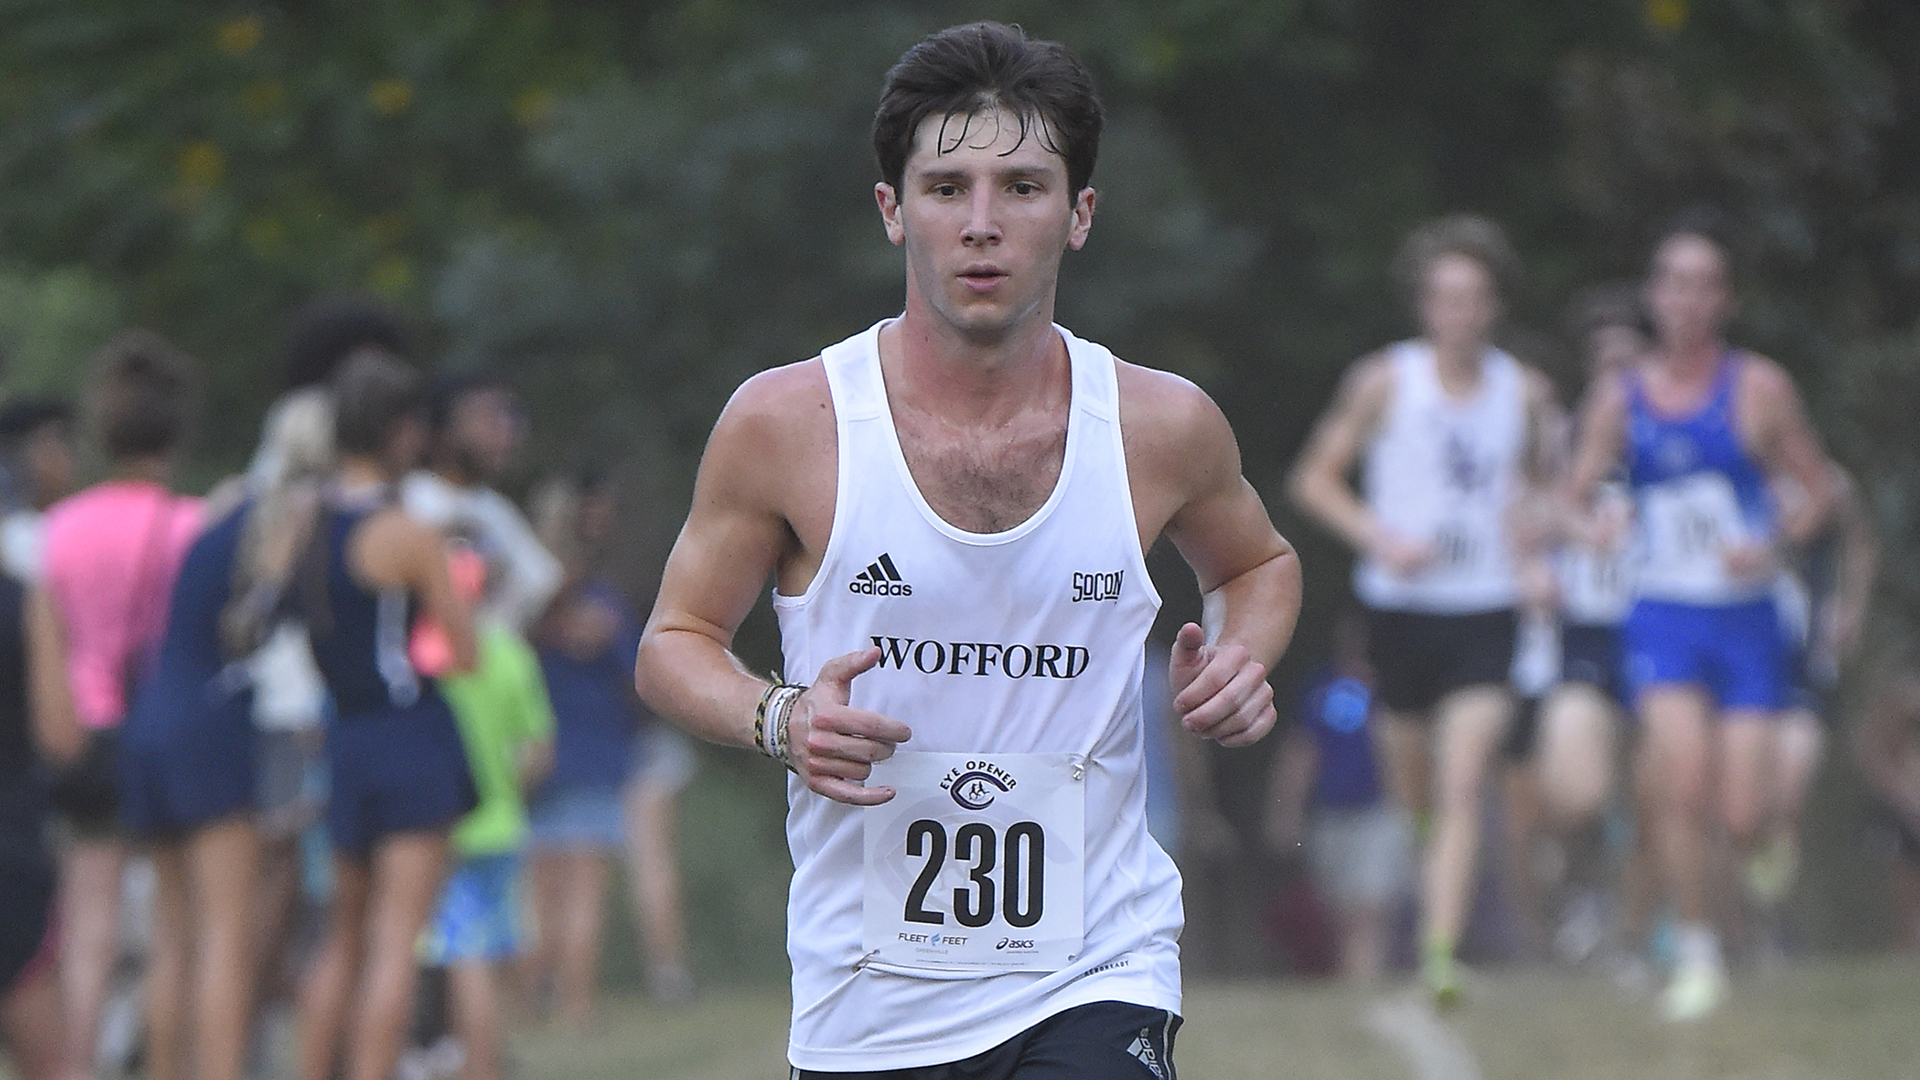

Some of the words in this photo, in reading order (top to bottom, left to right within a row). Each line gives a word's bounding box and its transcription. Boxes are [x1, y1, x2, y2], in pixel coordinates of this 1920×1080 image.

[849, 579, 912, 596] adidas
[870, 636, 1090, 679] WOFFORD
[939, 767, 961, 790] EYE
[965, 760, 1017, 789] OPENER
[903, 819, 1045, 928] 230
[898, 932, 928, 943] FLEET
[941, 936, 968, 945] FEET
